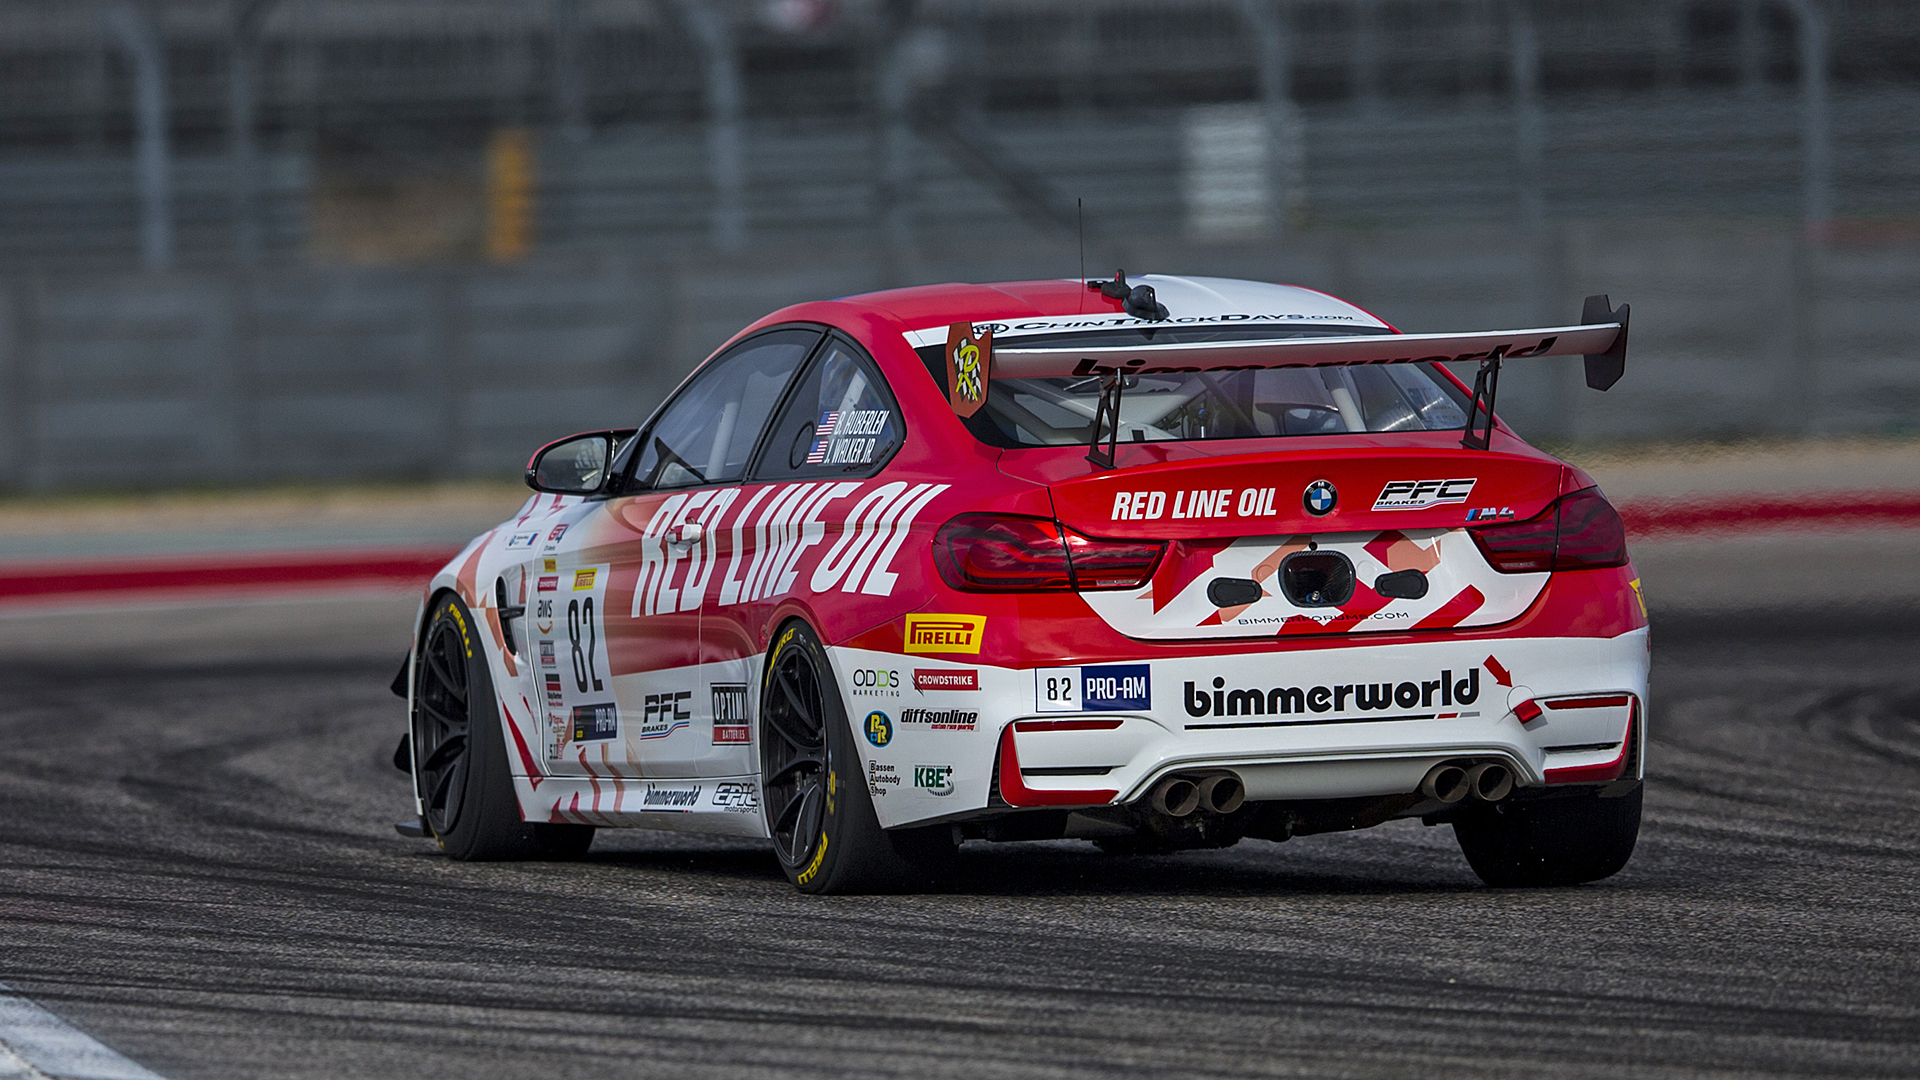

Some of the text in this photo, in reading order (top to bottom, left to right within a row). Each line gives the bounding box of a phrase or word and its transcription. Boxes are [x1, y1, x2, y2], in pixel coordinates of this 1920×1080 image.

[832, 438, 865, 464] WALKER
[1380, 479, 1476, 500] PFC
[1111, 487, 1277, 520] RED LINE OIL
[632, 481, 952, 618] RED LINE OIL
[1238, 612, 1410, 625] BIMMERFORUMS.COM
[909, 621, 975, 645] PIRELLI
[568, 596, 604, 694] 82
[853, 669, 899, 688] ODDS
[918, 675, 973, 685] CROWDSTRIKE
[1046, 677, 1146, 701] 82 PRO-AM
[853, 689, 899, 698] MARKETING
[1183, 667, 1480, 718] bimmerworld
[643, 690, 692, 723] PFC
[900, 709, 978, 725] diffsonline
[641, 724, 668, 733] BRAKES
[870, 763, 895, 772] Bassen
[870, 774, 901, 785] Autobody
[644, 782, 702, 806] bimmerworld
[870, 787, 886, 796] Shop
